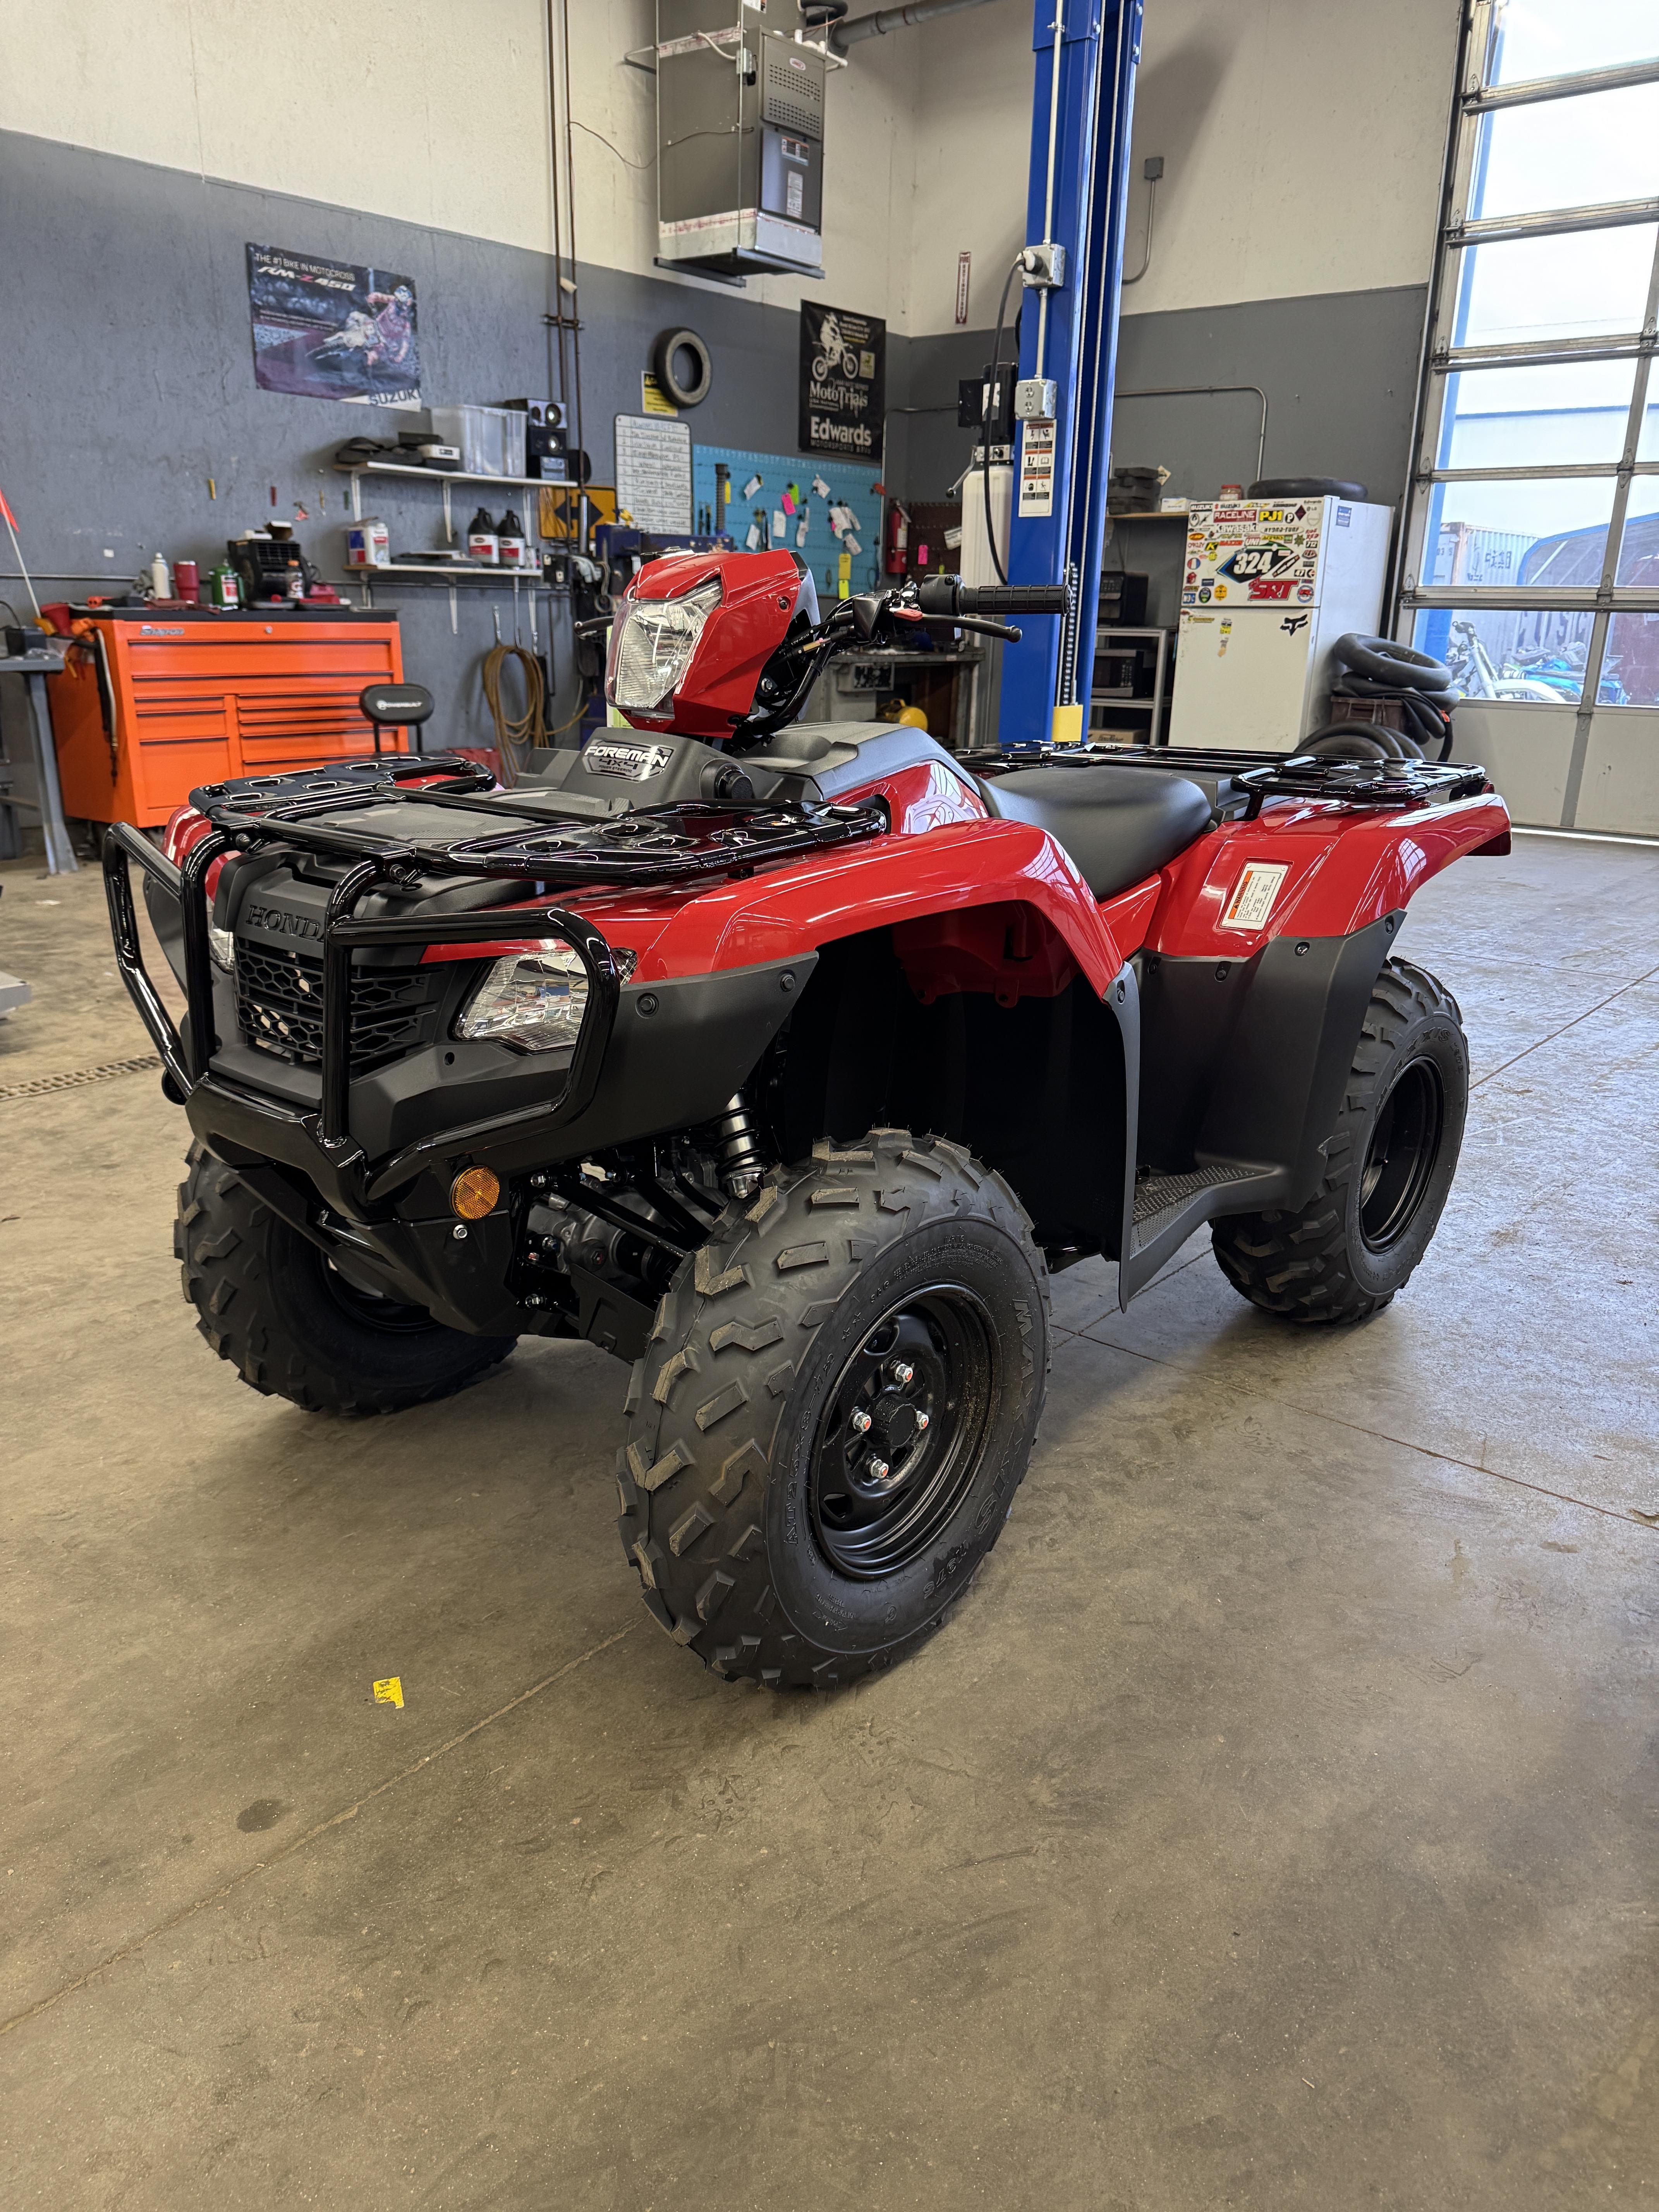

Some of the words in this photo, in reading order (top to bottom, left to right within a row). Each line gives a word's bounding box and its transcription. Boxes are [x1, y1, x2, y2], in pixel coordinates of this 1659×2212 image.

[255, 253, 271, 264] THE
[273, 257, 282, 266] #1
[283, 258, 300, 270] BIKE
[300, 262, 309, 272] IN
[309, 264, 356, 281] MOTOCROSS
[369, 388, 421, 405] SUZUKI
[811, 416, 872, 447] Edwards
[1214, 510, 1255, 519] RACELINE
[1259, 510, 1283, 522] PJ1
[1215, 523, 1258, 533] Kawasaki
[1233, 551, 1273, 574] 324
[584, 745, 669, 767] FOREMAN
[1235, 881, 1248, 905] WARNING
[246, 905, 324, 943] HOND
